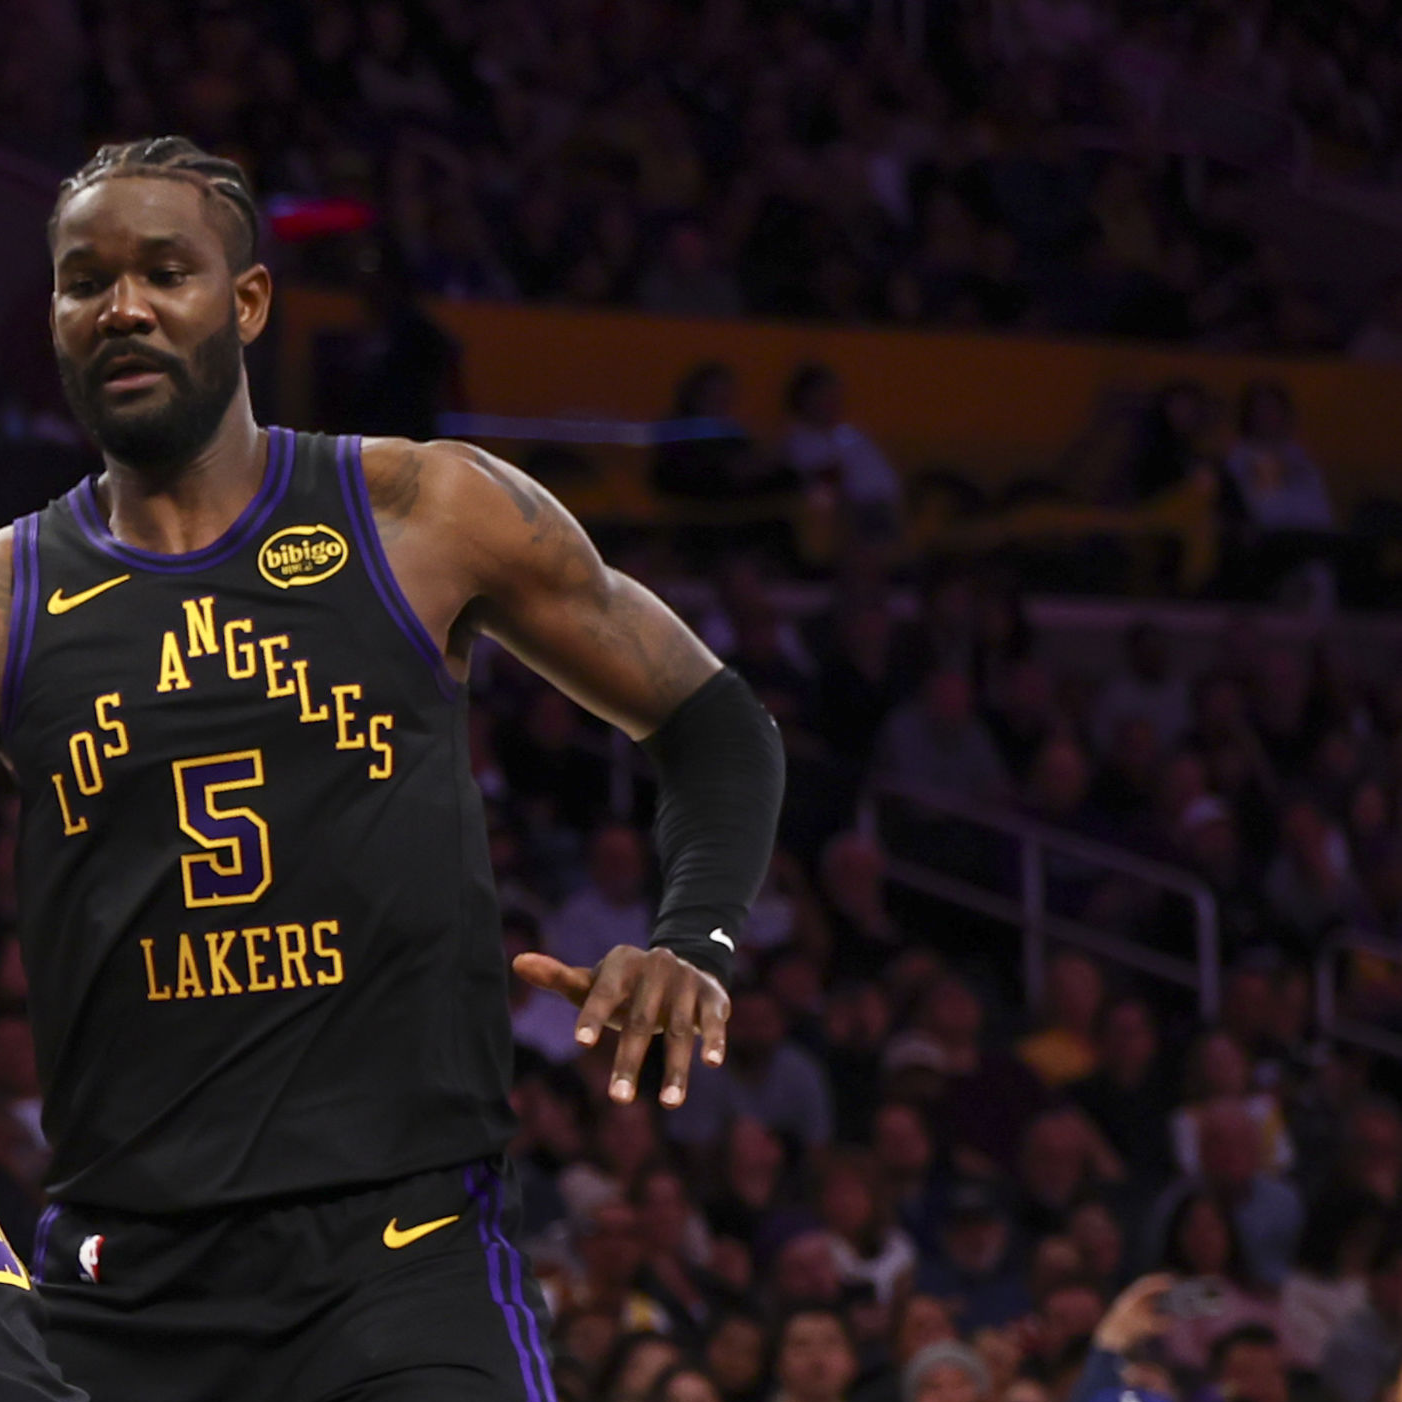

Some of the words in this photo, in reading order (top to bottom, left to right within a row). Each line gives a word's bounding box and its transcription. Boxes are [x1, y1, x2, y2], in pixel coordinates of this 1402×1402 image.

[265, 539, 342, 569] bibigo
[51, 692, 131, 837] LOS
[156, 595, 395, 782] ANGELES
[170, 748, 274, 909] 5
[139, 919, 345, 1003] LAKERS
